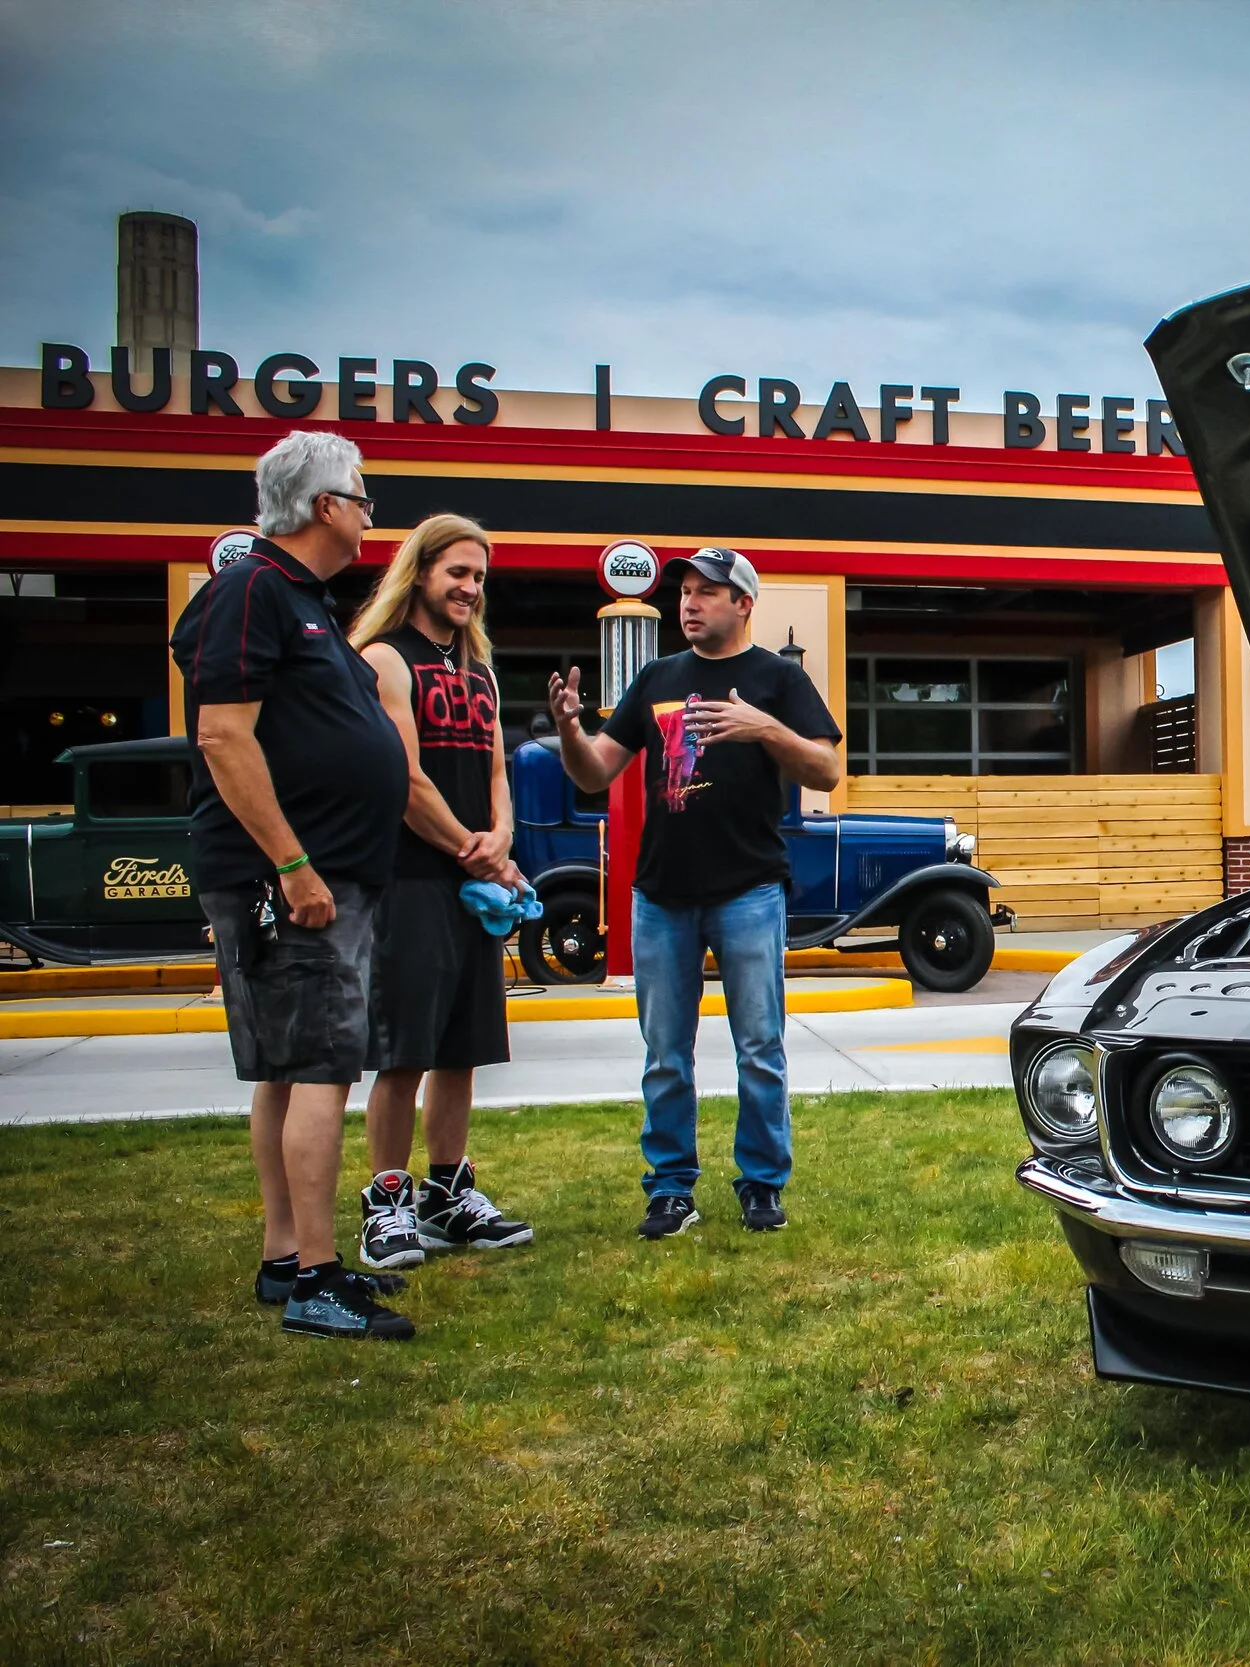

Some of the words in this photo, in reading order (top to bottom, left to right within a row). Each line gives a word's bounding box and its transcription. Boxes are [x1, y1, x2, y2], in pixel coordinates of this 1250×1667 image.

[41, 342, 499, 426] BURGERS
[698, 374, 961, 445] CRAFT
[103, 857, 189, 885] Ford's
[107, 885, 188, 897] GARAGE
